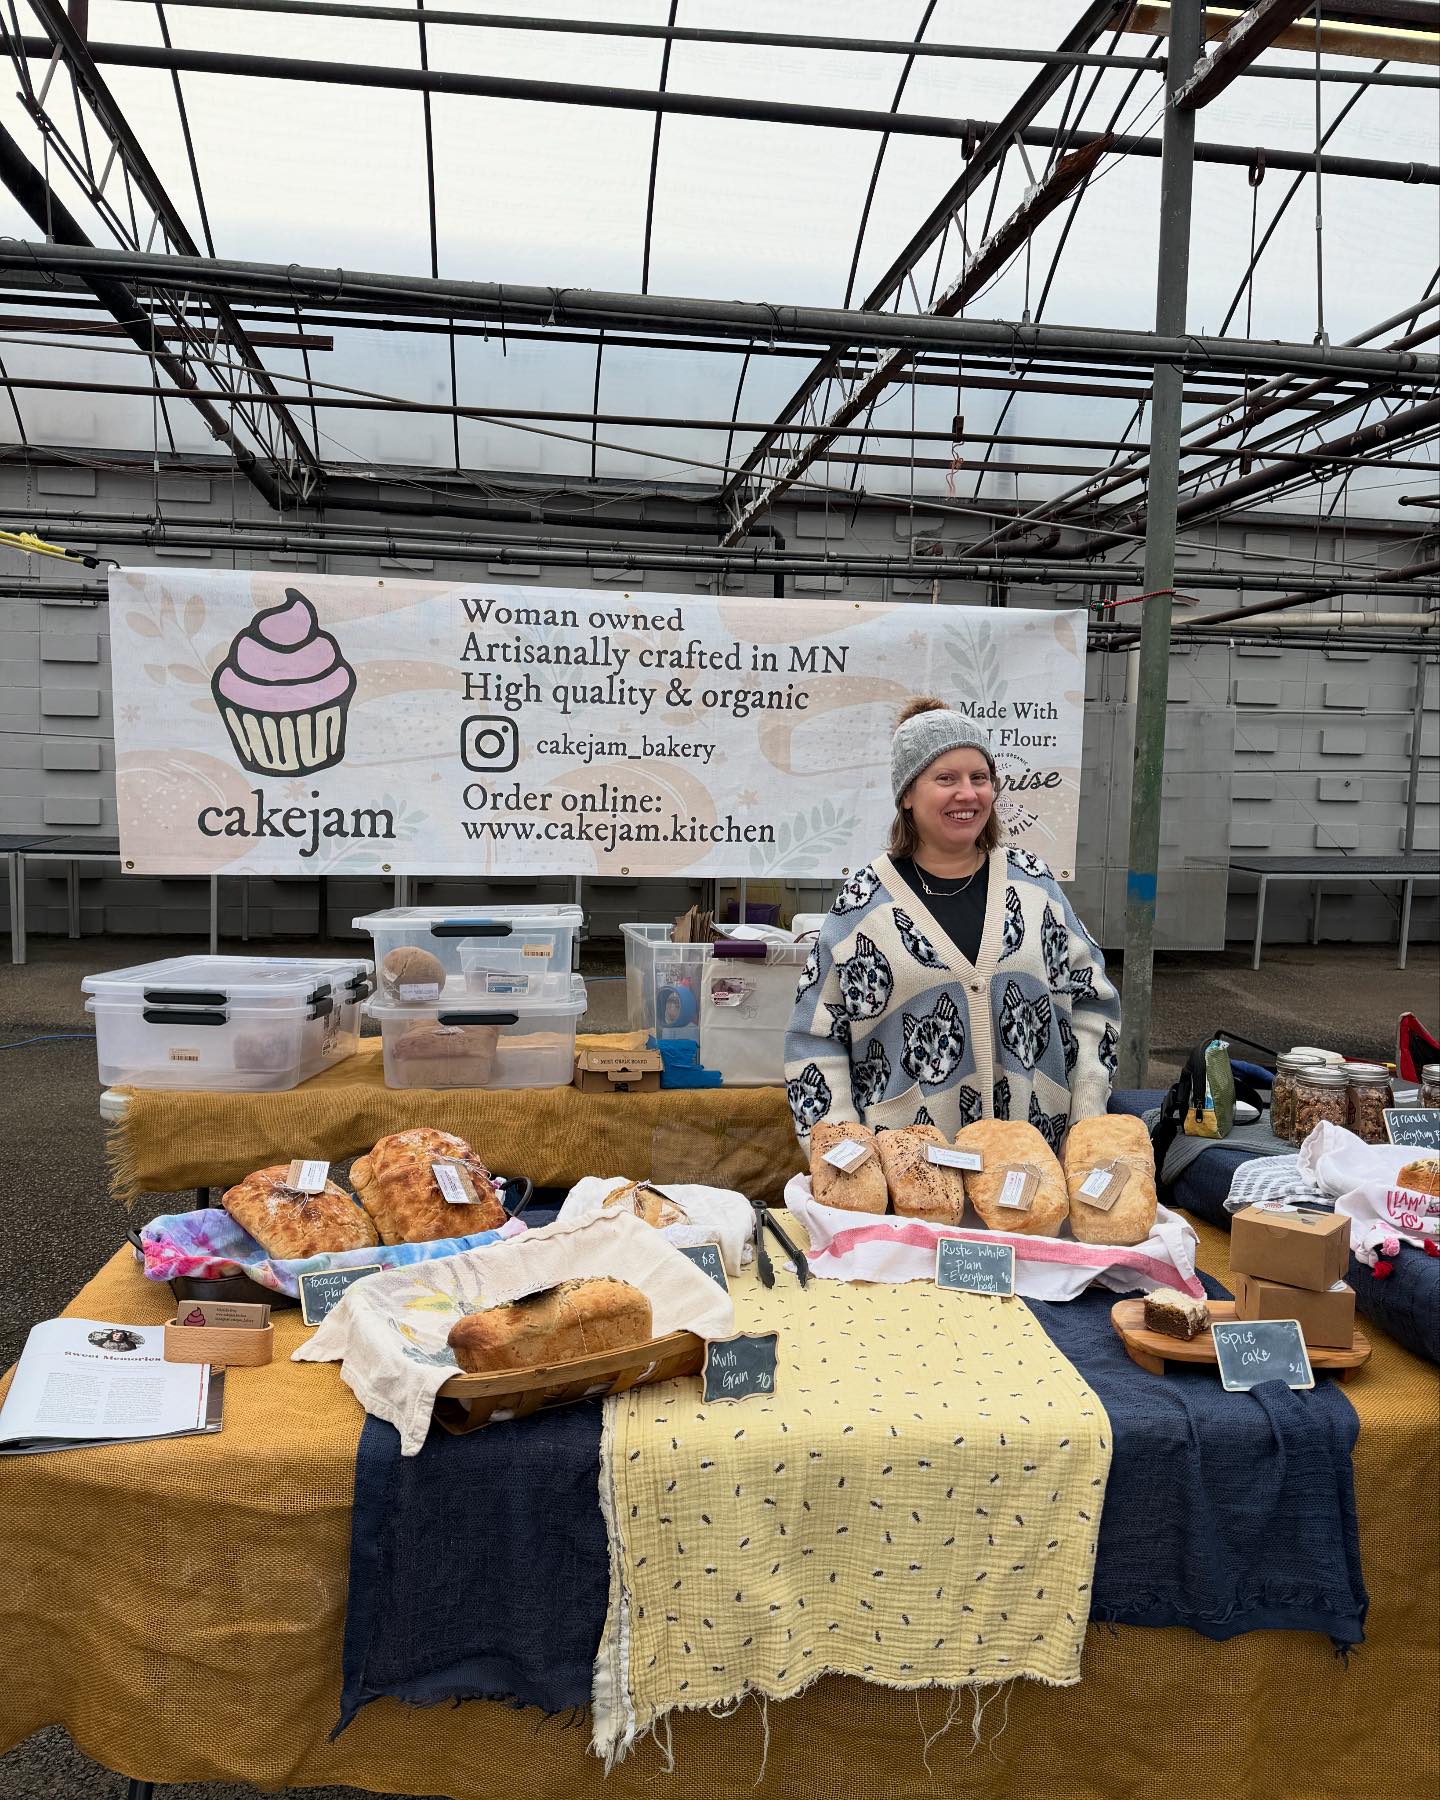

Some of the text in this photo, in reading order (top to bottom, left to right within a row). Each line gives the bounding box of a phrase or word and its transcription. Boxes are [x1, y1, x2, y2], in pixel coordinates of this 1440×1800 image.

[460, 598, 686, 631] Woman owned
[460, 632, 850, 676] Artisanally crafted in MN
[461, 672, 810, 717] High quality & organic
[960, 701, 1059, 720] Made With
[536, 732, 717, 764] cakejam_bakery
[1000, 728, 1057, 747] Flour:
[1001, 768, 1062, 792] rise
[462, 783, 662, 813] Order online:
[197, 789, 397, 858] cakejam
[461, 812, 776, 852] www.cakejam.kitchen
[1008, 813, 1039, 837] MILL
